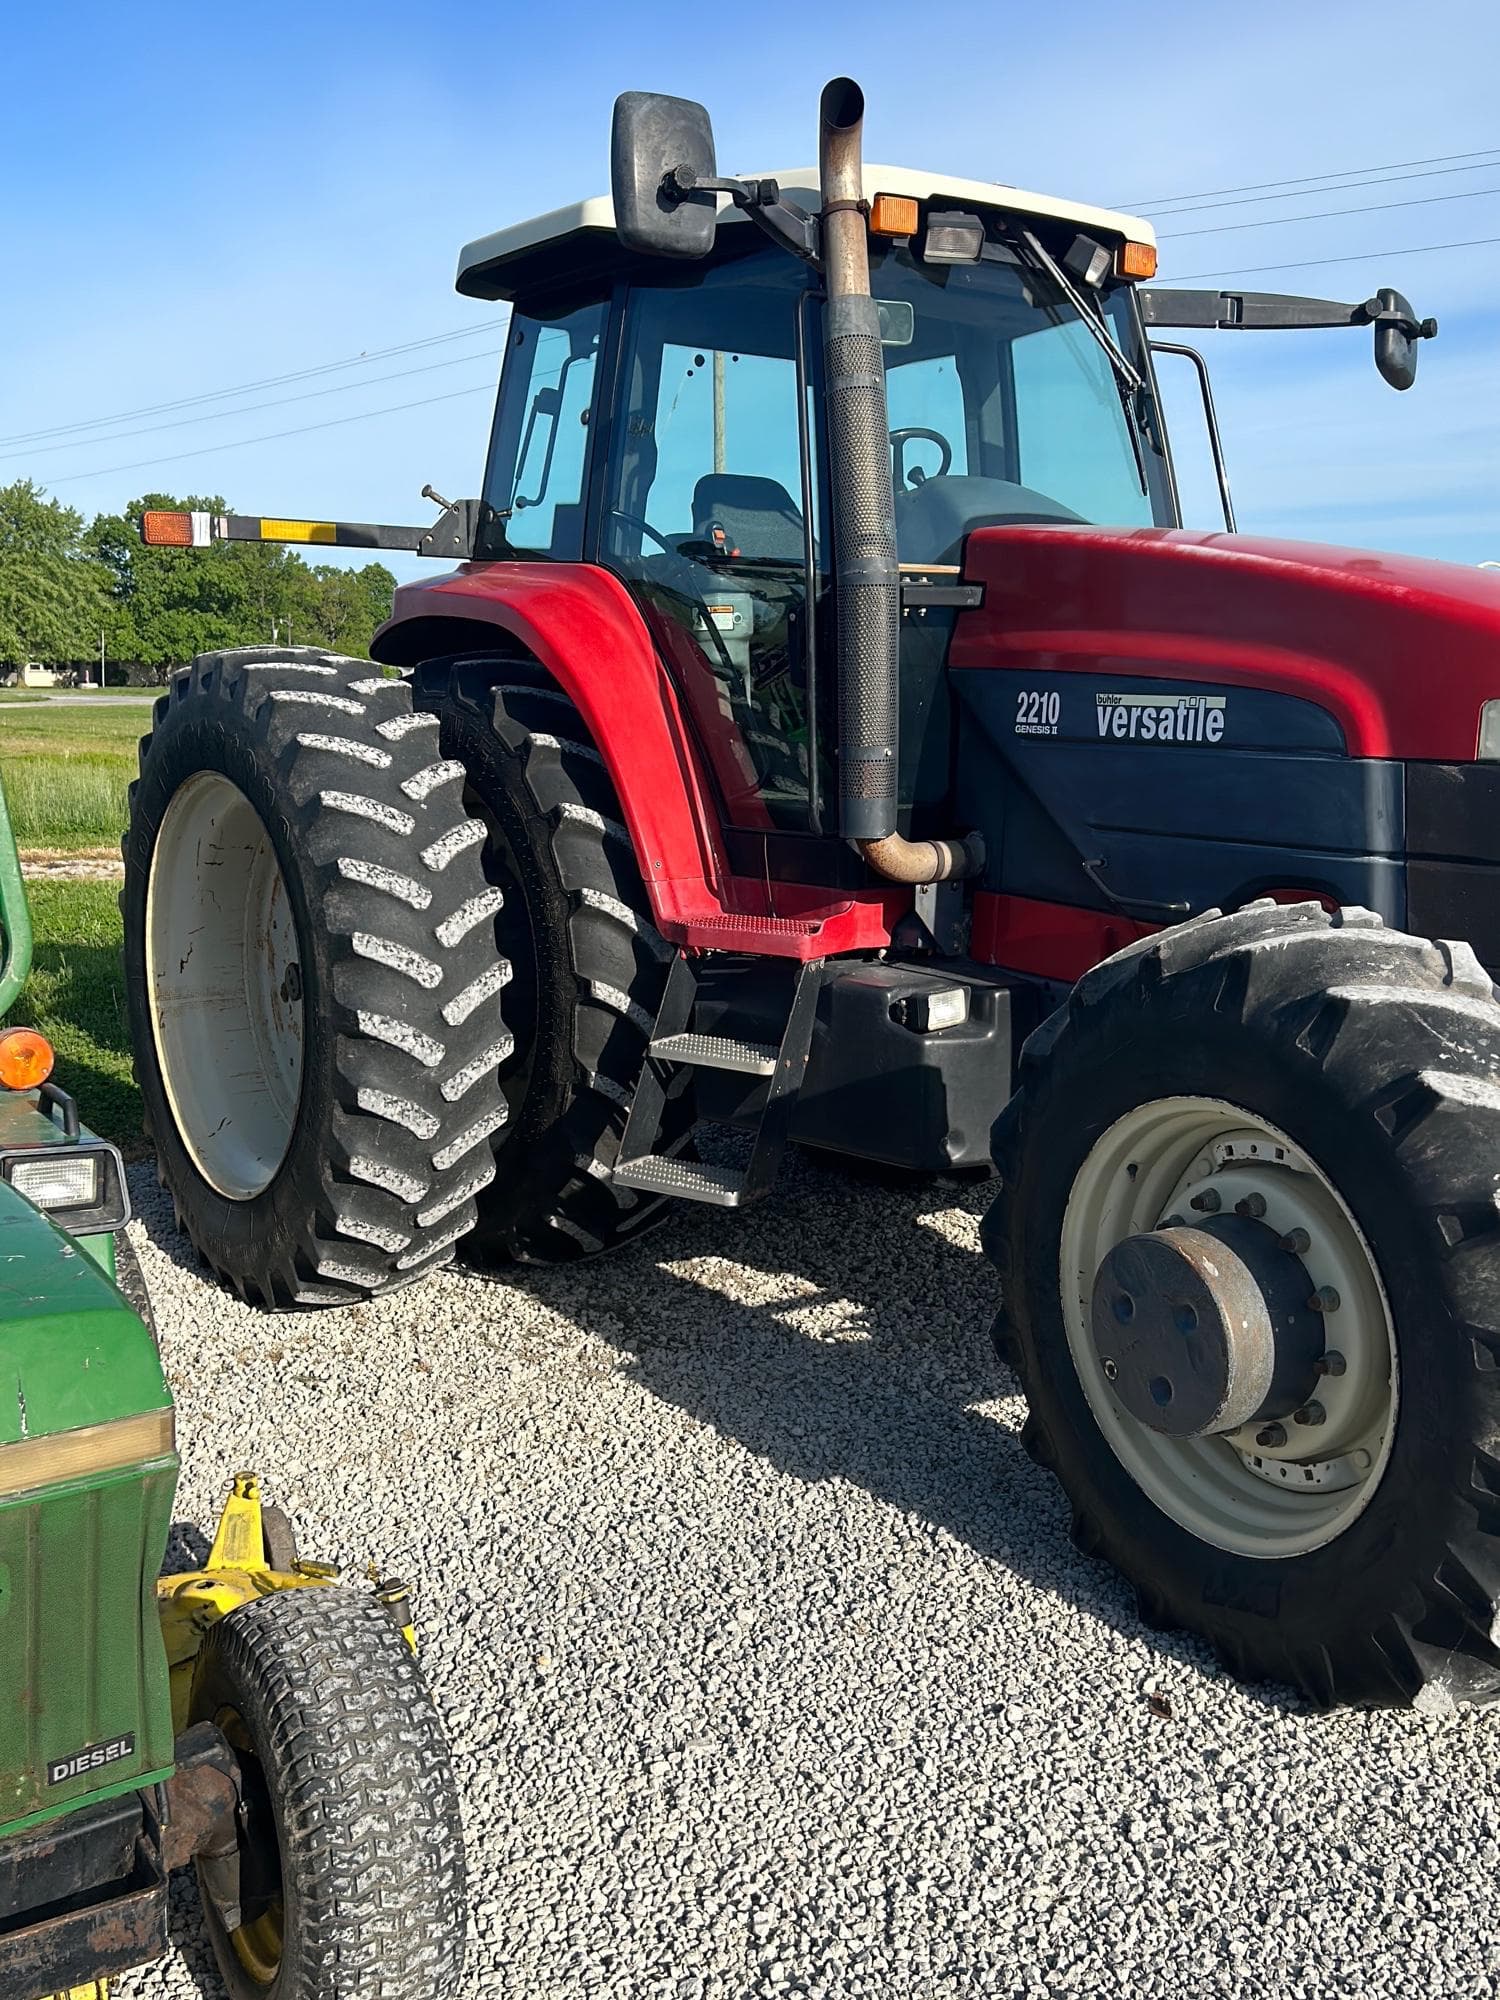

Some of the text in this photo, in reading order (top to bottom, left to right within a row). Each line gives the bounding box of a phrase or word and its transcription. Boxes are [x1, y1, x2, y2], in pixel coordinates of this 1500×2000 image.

[1015, 691, 1060, 725] 2210
[1097, 697, 1225, 743] versatile
[1015, 724, 1050, 734] GENESIS
[53, 1740, 132, 1782] DIESEL
